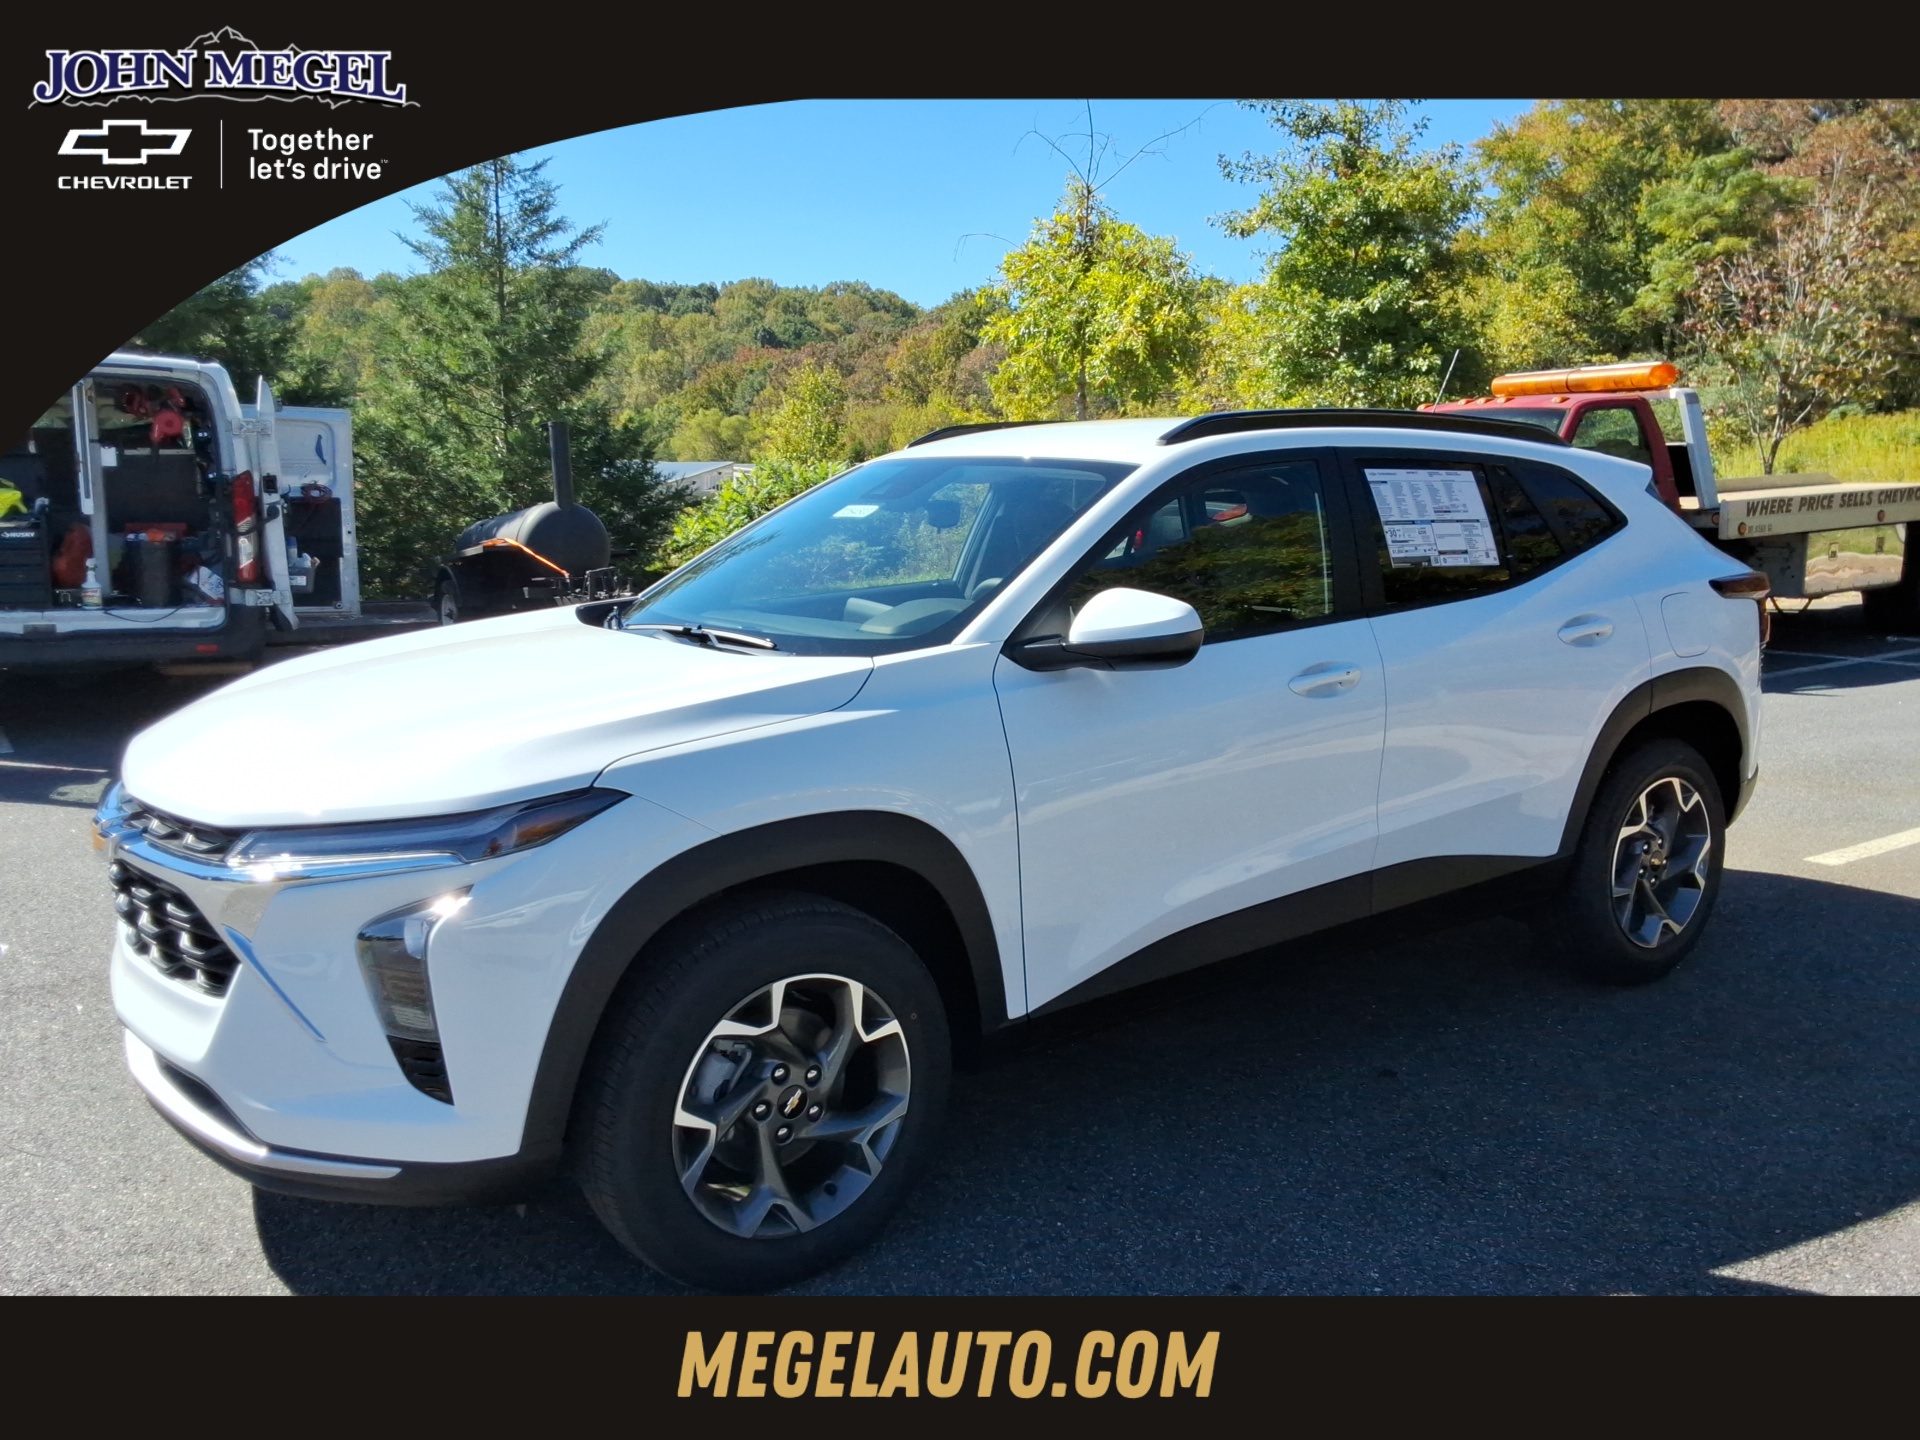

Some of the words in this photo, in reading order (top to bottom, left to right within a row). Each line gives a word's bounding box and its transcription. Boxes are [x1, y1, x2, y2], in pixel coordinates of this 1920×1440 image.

[1746, 498, 1793, 518] WHERE
[1798, 493, 1834, 513] PRICE
[1839, 491, 1873, 508] SELLS
